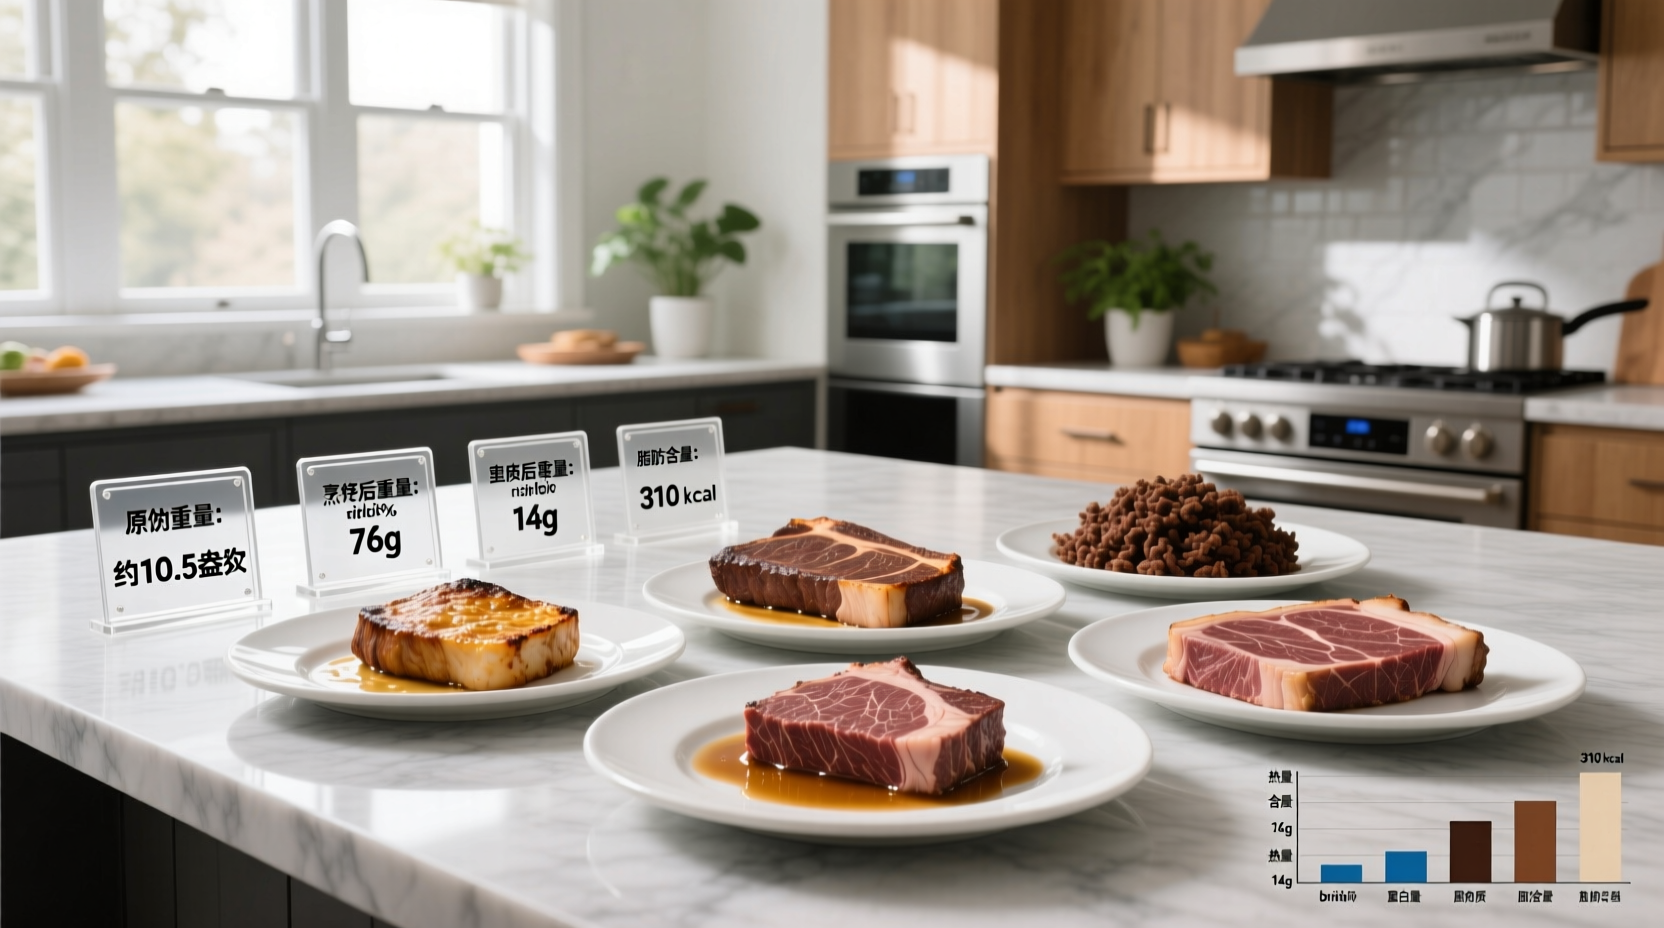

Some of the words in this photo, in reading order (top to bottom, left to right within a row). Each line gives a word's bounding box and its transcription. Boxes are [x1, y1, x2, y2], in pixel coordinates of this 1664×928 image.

[639, 484, 679, 510] 310
[683, 484, 717, 505] kcal
[513, 504, 558, 536] 14g
[349, 525, 402, 559] 76g
